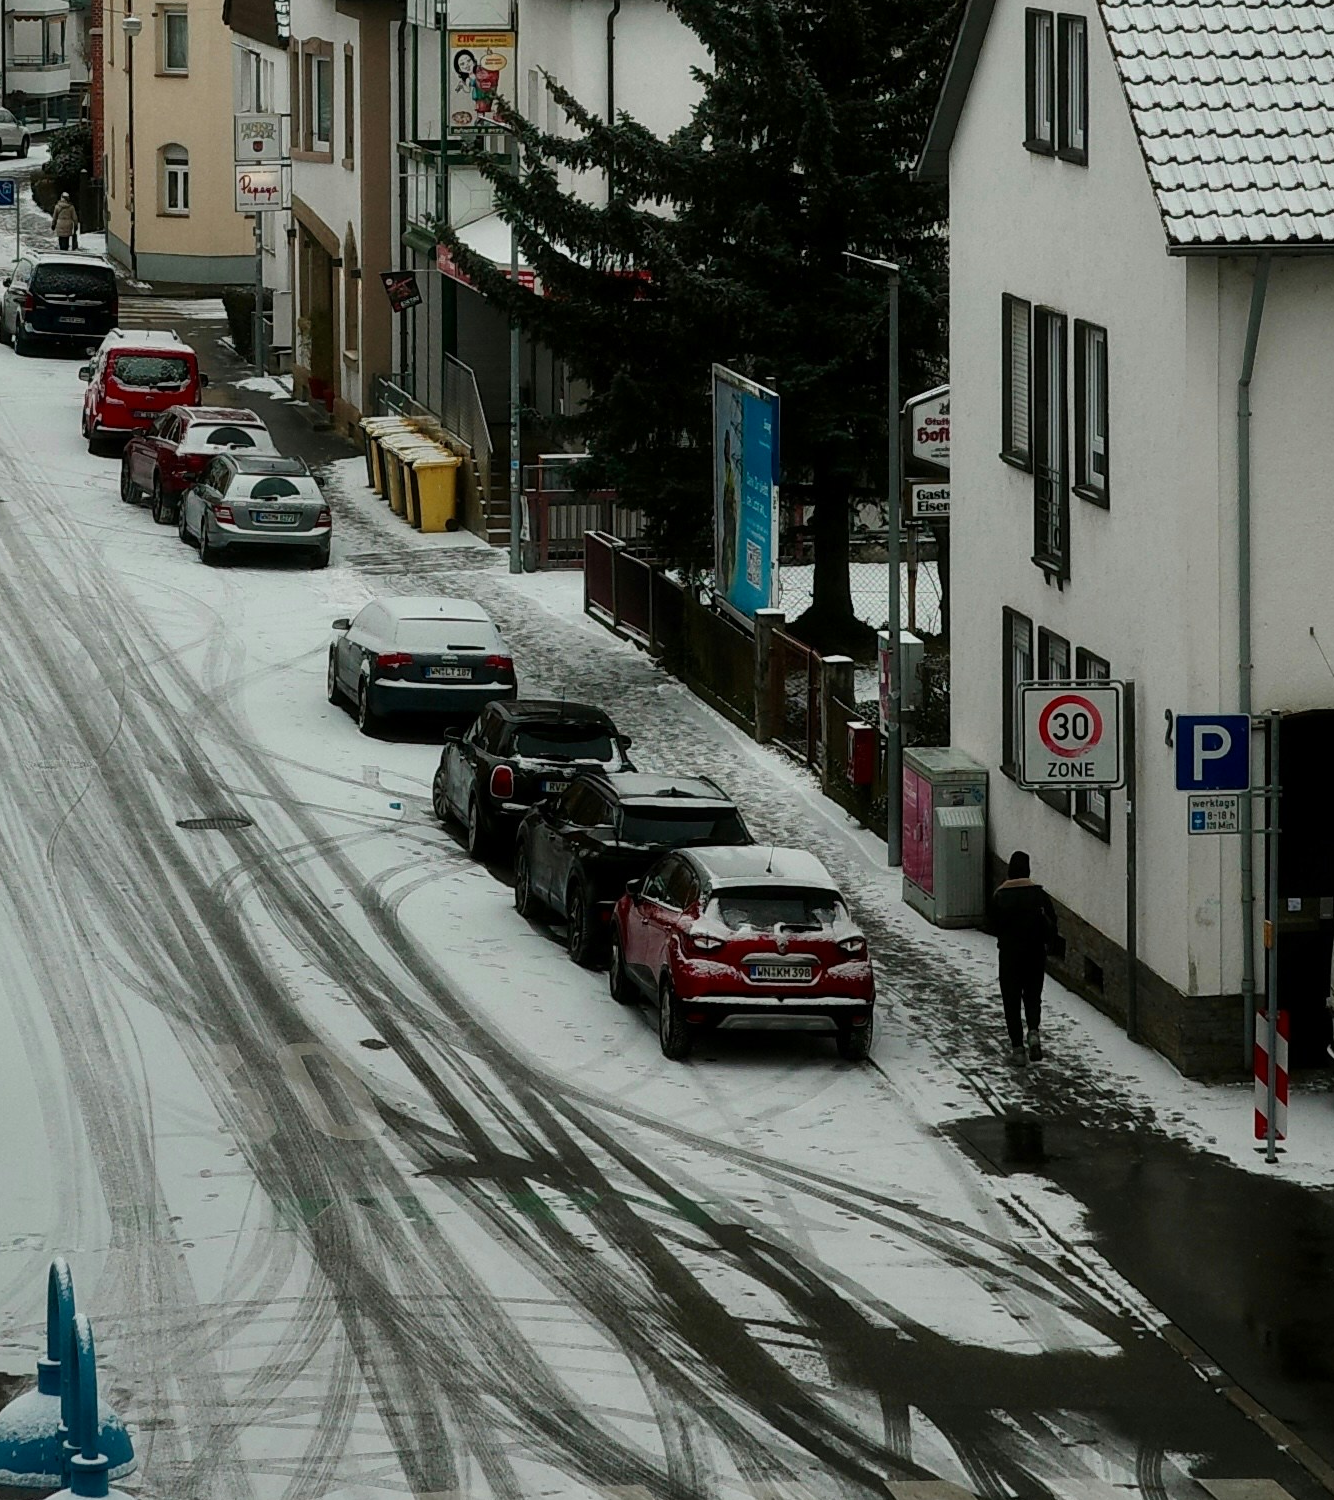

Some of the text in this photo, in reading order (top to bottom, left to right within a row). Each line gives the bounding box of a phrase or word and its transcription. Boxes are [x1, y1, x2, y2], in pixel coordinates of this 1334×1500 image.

[1052, 712, 1089, 741] 30
[1192, 723, 1232, 782] P
[1047, 761, 1095, 778] ZONE
[1191, 798, 1236, 810] werktags
[1207, 810, 1235, 820] 8-18 h
[756, 965, 811, 978] WN KM 398
